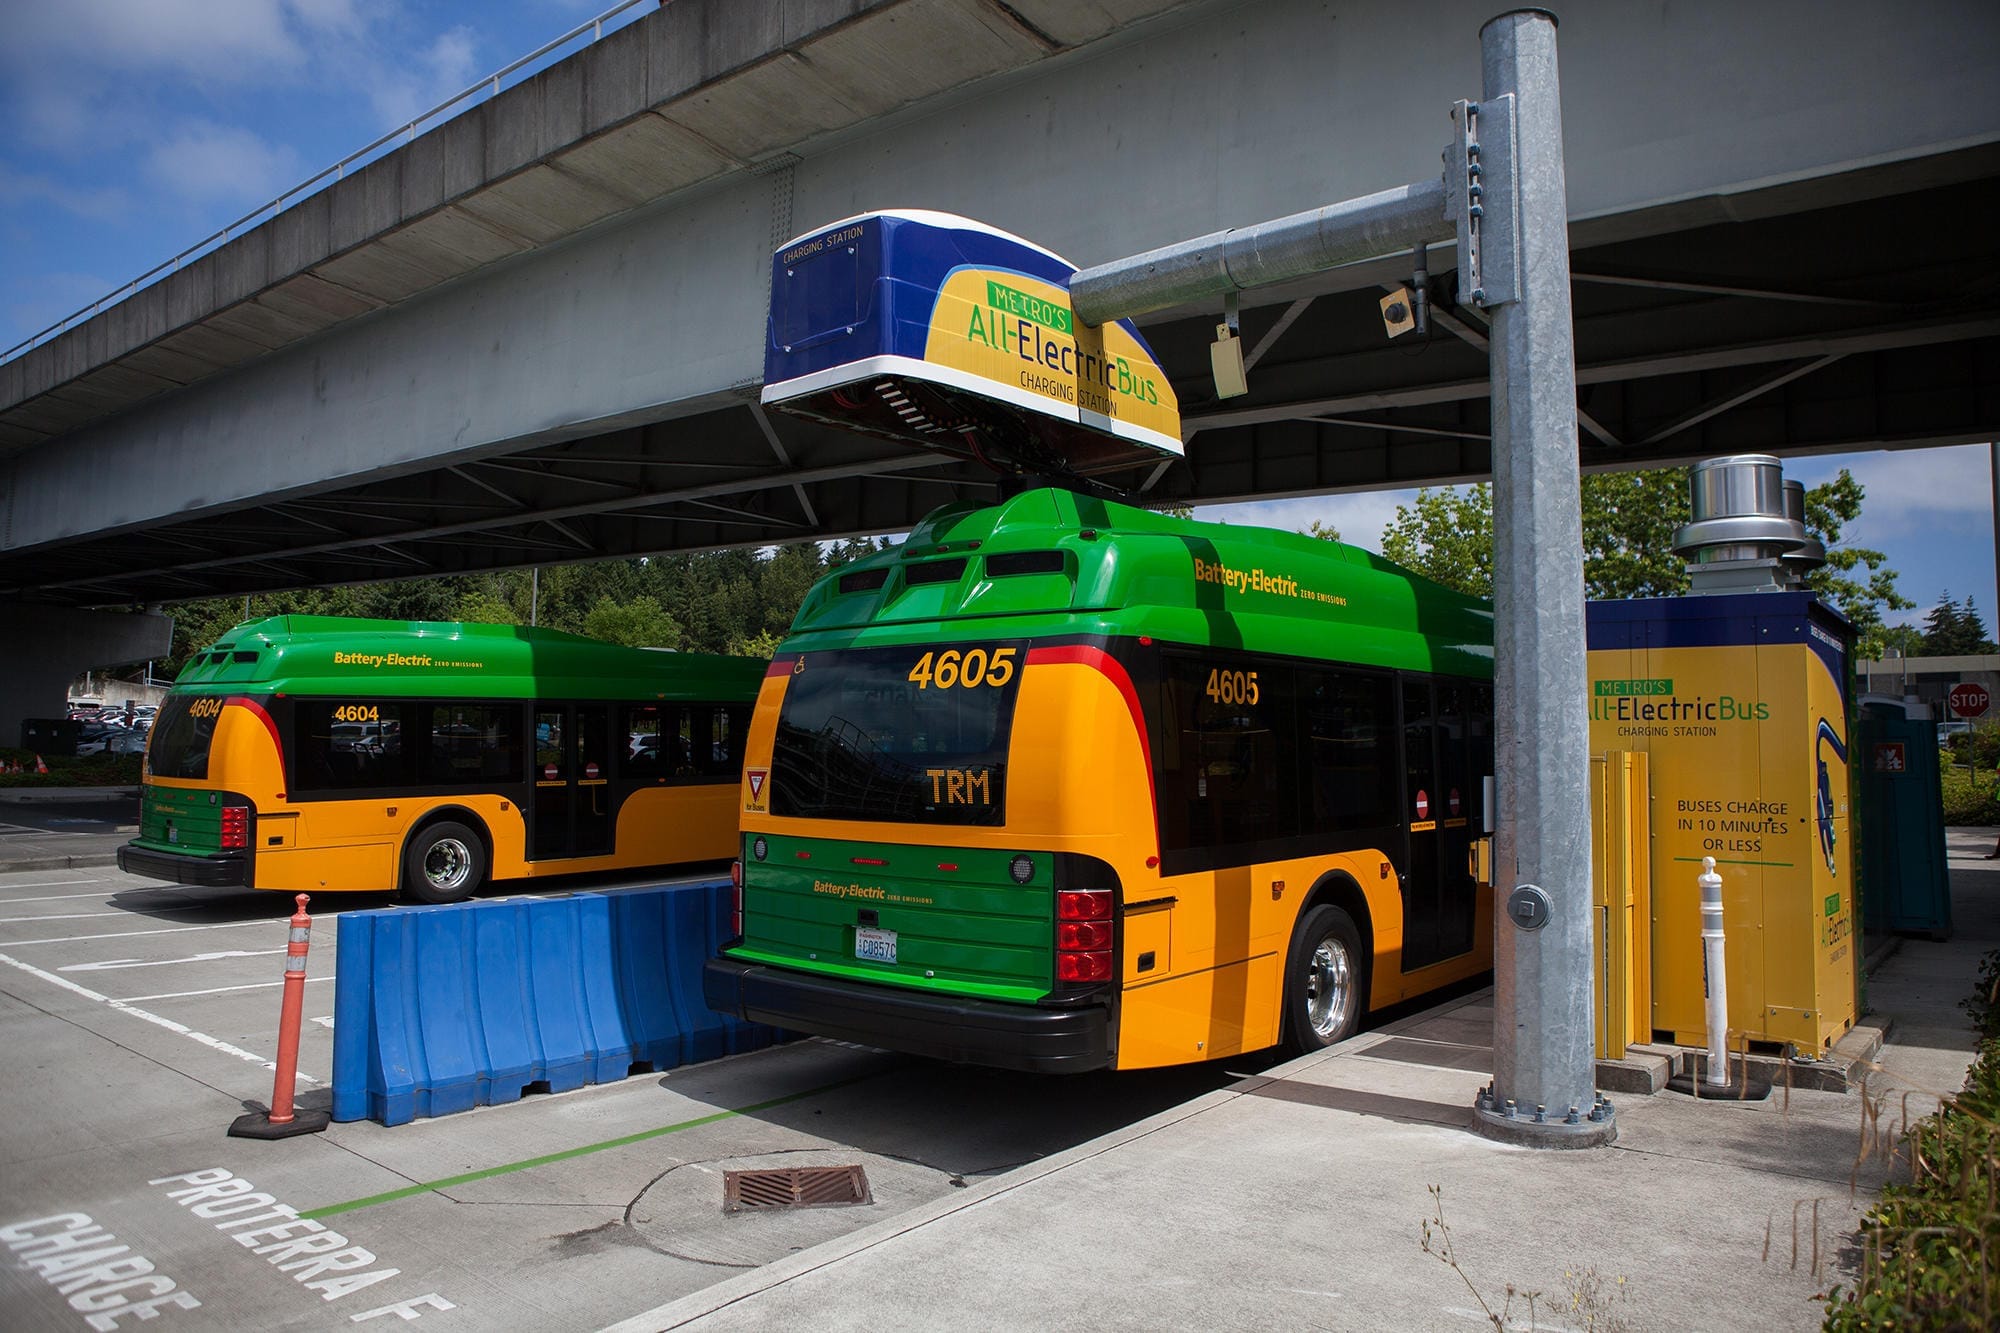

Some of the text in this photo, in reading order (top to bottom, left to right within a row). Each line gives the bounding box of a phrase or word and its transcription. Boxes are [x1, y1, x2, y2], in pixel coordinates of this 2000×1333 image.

[783, 225, 864, 264] CHARGING STATION
[995, 287, 1066, 331] METRO'S
[1020, 370, 1117, 417] CHARGING STATION
[1194, 558, 1347, 606] Battery-Electric ZERO EMISSIONS
[334, 651, 432, 668] Battery-Electric
[908, 648, 1017, 690] 4605
[1206, 669, 1259, 705] 4605
[1601, 681, 1666, 694] METRO'S
[189, 699, 223, 718] 4604
[1589, 696, 1770, 721] ll-ElectricBus
[1951, 694, 1988, 707] STOP
[335, 705, 379, 722] 4604
[1617, 726, 1717, 737] CHARGING STATION
[927, 769, 990, 805] TRM
[1677, 800, 1789, 815] BUSES CHARGE
[1678, 819, 1789, 834] IN 10 MINUTES
[1703, 838, 1762, 852] OR LESS
[814, 880, 885, 899] Battery-Electric
[148, 1167, 400, 1301] PROTERRA
[0, 1212, 202, 1332] CHARGE
